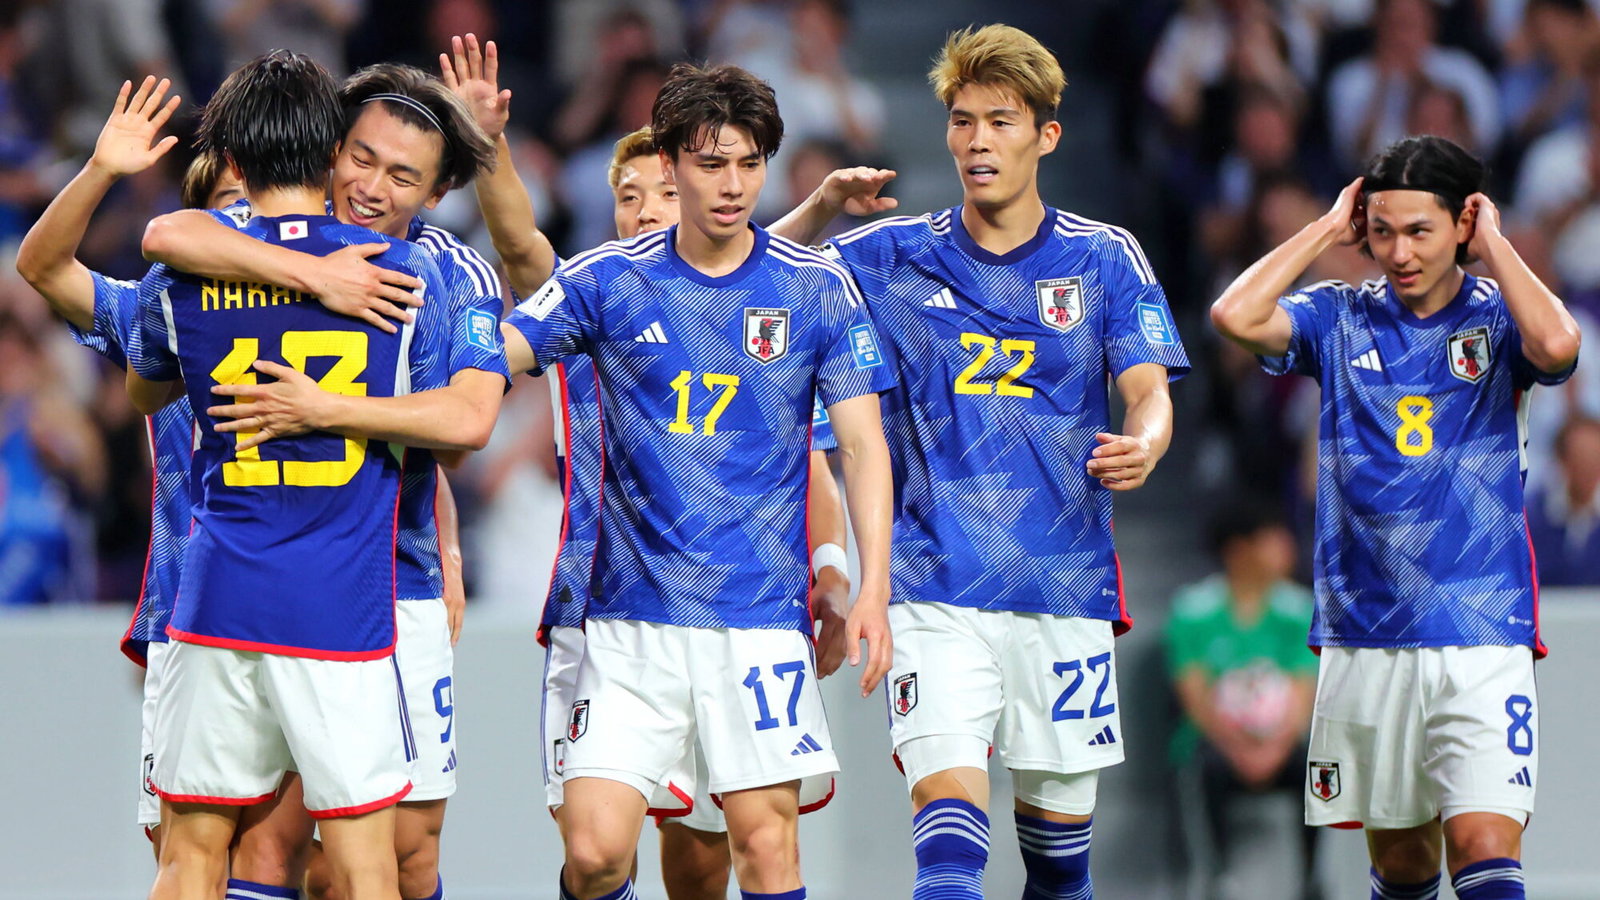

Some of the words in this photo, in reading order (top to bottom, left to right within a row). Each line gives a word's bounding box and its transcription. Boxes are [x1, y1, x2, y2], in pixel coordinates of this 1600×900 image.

[201, 279, 302, 312] NAKA
[1053, 313, 1073, 323] JFA
[755, 346, 775, 355] JFA
[954, 332, 1036, 399] 22
[1456, 330, 1479, 338] JAPAN
[210, 330, 369, 487] 13
[668, 370, 740, 436] 17
[1396, 395, 1434, 456] 8
[432, 675, 453, 743] 9
[742, 660, 806, 731] 17
[1052, 651, 1115, 722] 22
[1505, 694, 1533, 756] 8
